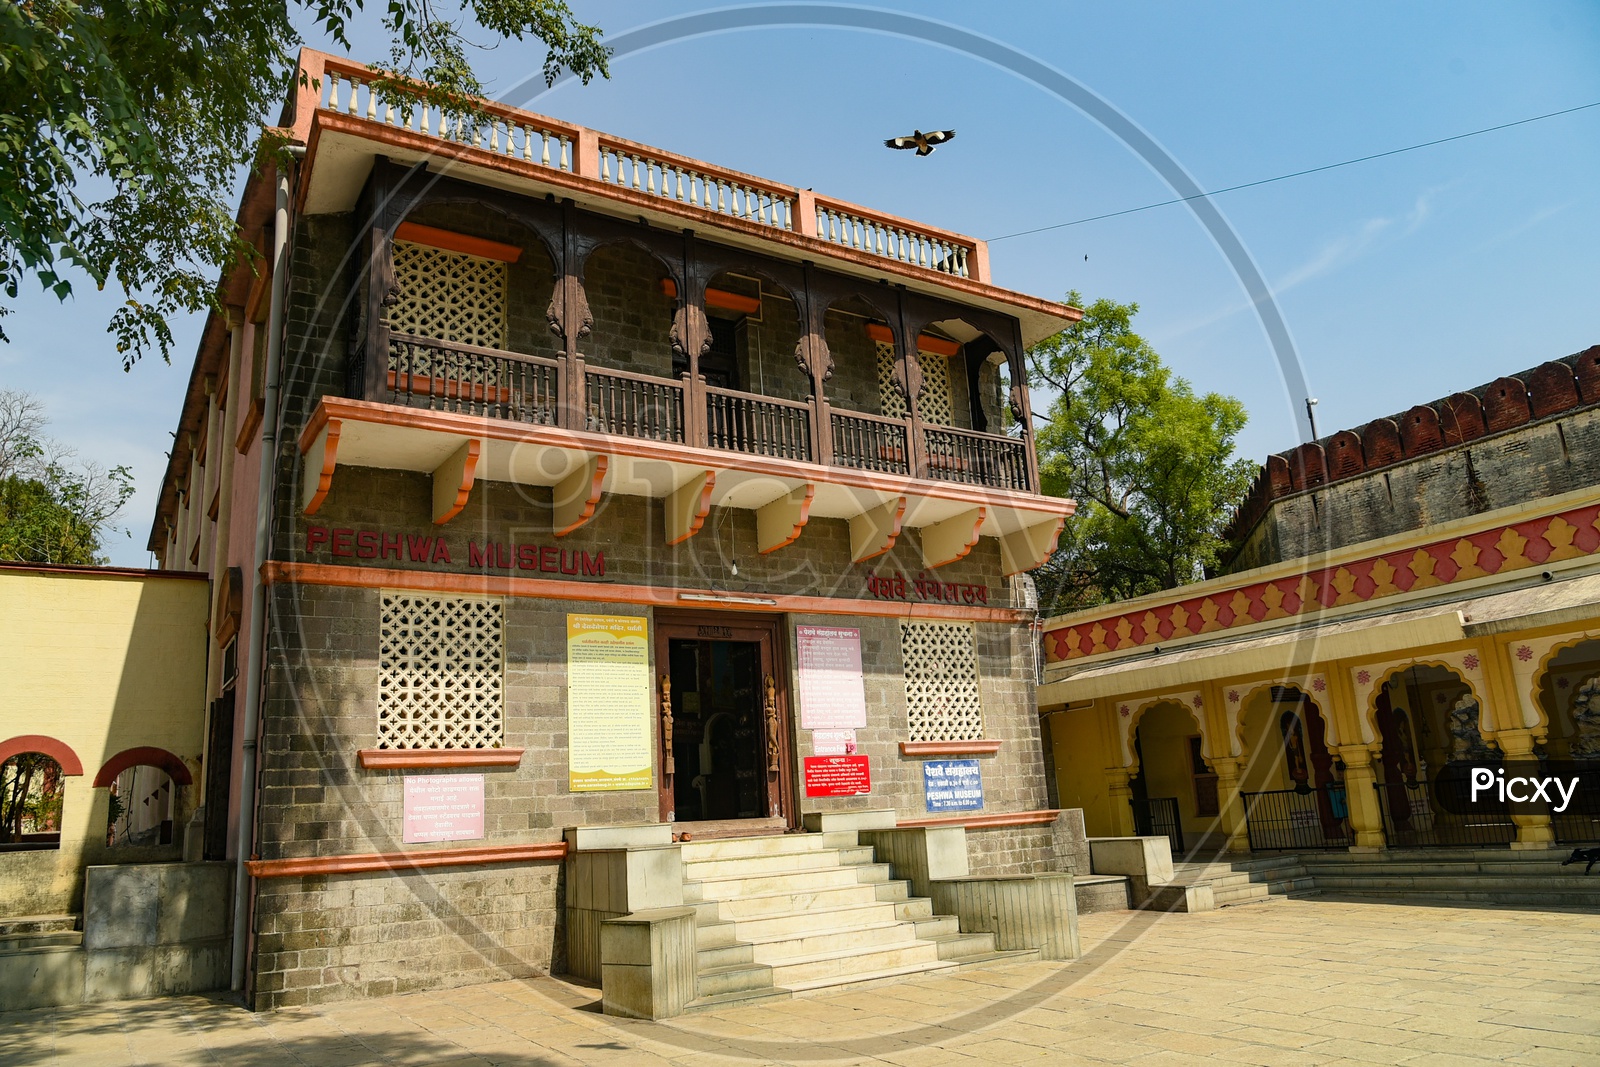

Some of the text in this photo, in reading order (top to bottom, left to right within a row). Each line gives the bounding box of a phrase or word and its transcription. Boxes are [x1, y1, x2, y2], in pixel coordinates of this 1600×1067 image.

[306, 526, 606, 577] PESHWA MUSEUM
[865, 570, 988, 605] पेशवे संग्रहालय
[814, 745, 836, 753] Entrance
[925, 762, 979, 778] पेशवे संग्रहालय
[417, 777, 457, 785] Photographs
[926, 790, 982, 800] PESHWA MUSEUM
